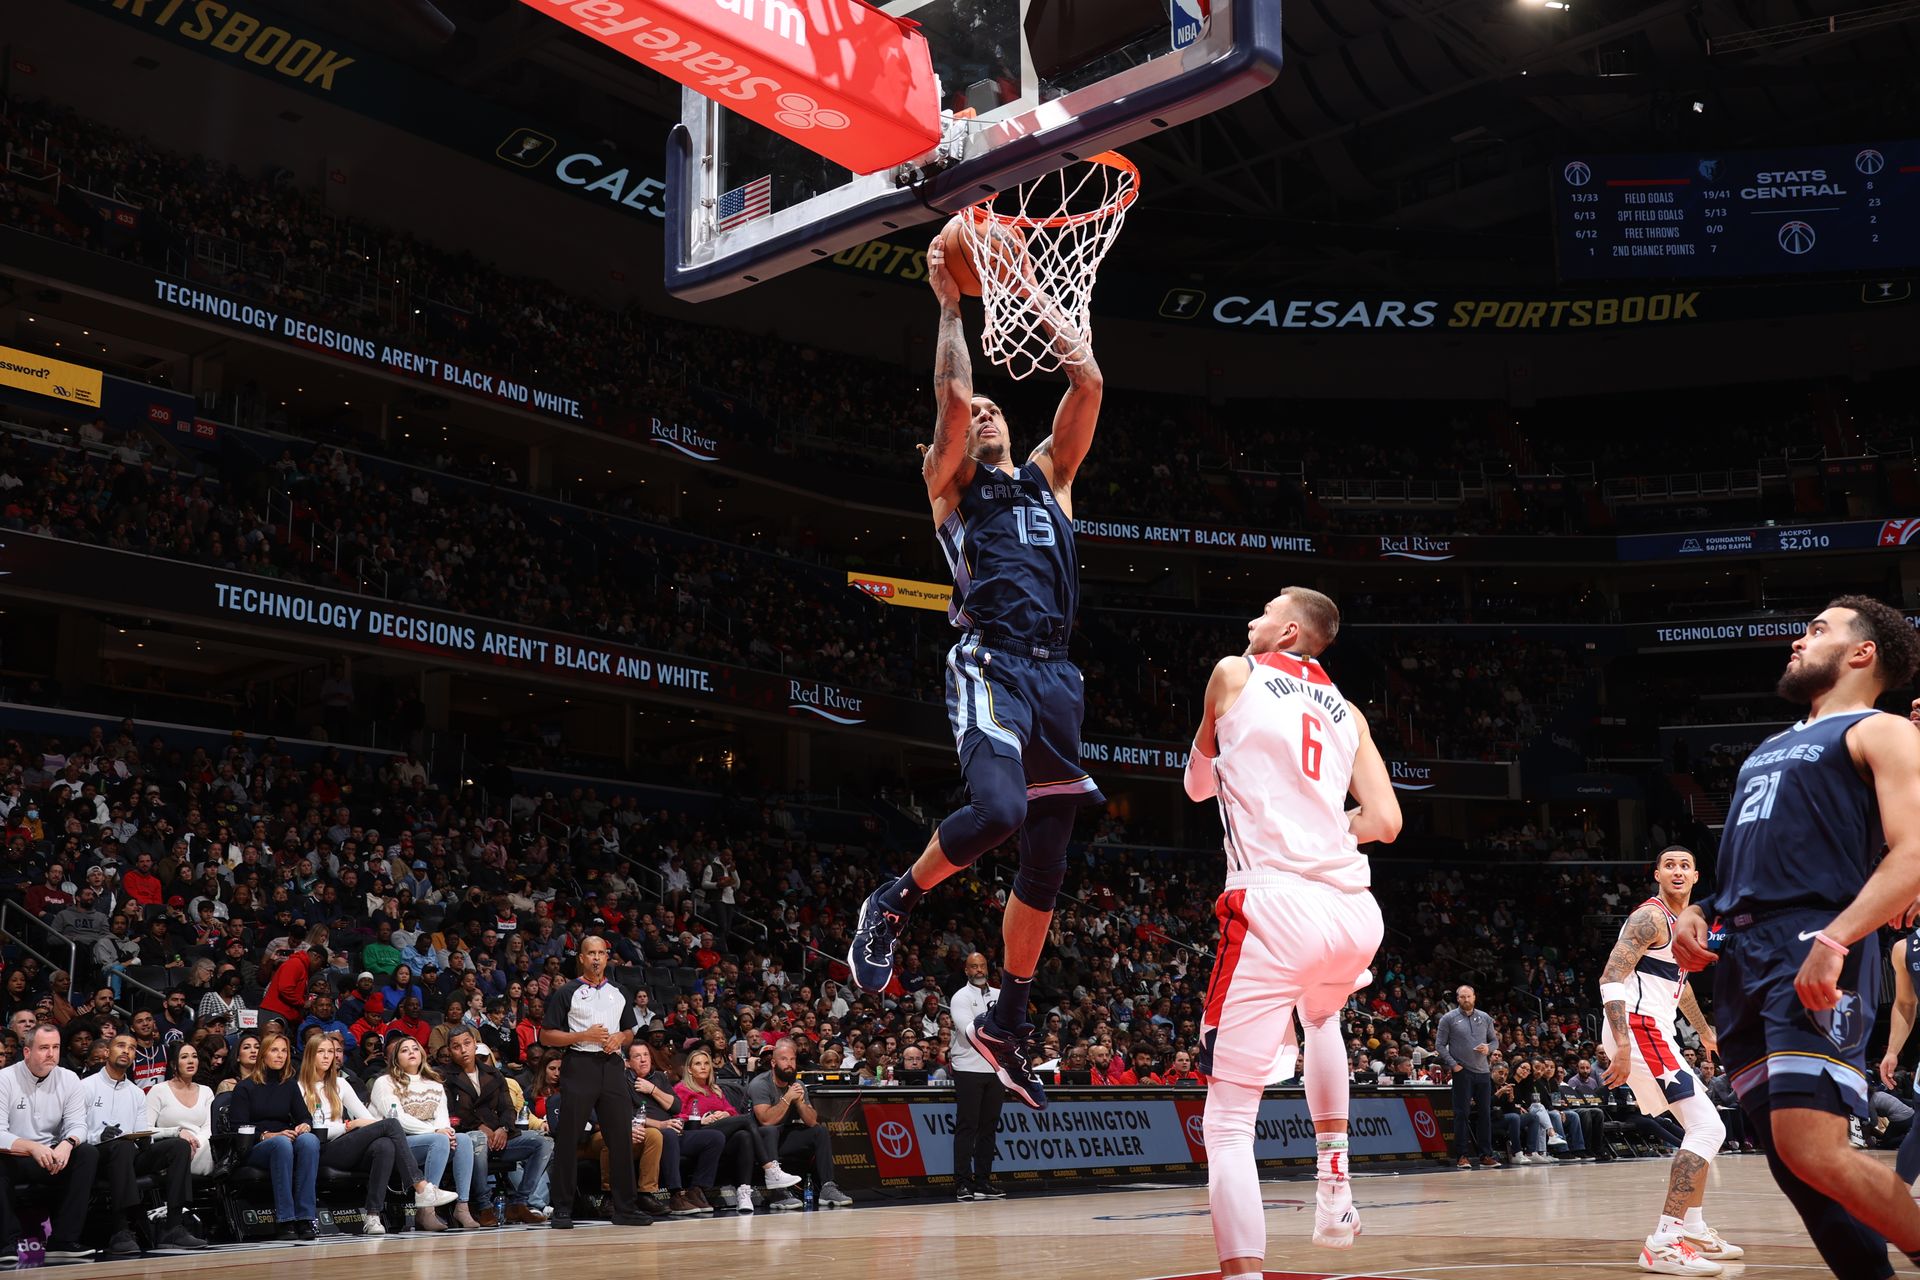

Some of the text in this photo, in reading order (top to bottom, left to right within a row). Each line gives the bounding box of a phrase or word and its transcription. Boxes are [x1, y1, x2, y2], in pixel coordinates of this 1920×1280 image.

[1177, 22, 1197, 45] NBA
[1756, 169, 1828, 185] STATS
[1740, 183, 1847, 200] CENTRAL
[1866, 181, 1874, 190] 8
[1571, 193, 1599, 202] 13/33
[1624, 192, 1674, 204] FIELD GOALS
[1703, 190, 1731, 199] 19/41
[1867, 197, 1881, 207] 23
[1573, 211, 1596, 220] 6/13
[1617, 209, 1684, 222] 3PT FIELD GOALS
[1704, 208, 1727, 217] 5/13
[1869, 215, 1877, 224] 2
[1575, 230, 1598, 239] 6/12
[1624, 227, 1680, 239] FREE THROWS
[1706, 224, 1724, 234] 0/0
[1872, 233, 1880, 243] 2
[1612, 243, 1696, 257] 2ND CHANCE POINTS
[1710, 245, 1718, 254] 7
[1212, 290, 1701, 328] CAESARS SPORTSBOOK
[154, 279, 584, 420] TECHNOLOGY DECISIONS AREN'T BLACK AND WHITE.
[151, 408, 169, 420] 200
[196, 423, 214, 436] 229
[651, 417, 718, 451] Red River
[1012, 505, 1056, 547] 15
[1779, 529, 1812, 537] JACKPOT
[1073, 518, 1316, 552] DECISIONS AREN'T BLACK AND WHITE.
[1706, 536, 1751, 544] FOUNDATION
[1380, 536, 1451, 552] Red River
[1780, 535, 1830, 550] $2,010
[898, 587, 922, 598] What's
[924, 592, 938, 601] your
[214, 583, 714, 693] TECHNOLOGY DECISIONS AREN'T BLACK AND WHITE.
[1657, 625, 1743, 642] TECHNOLOGY
[790, 680, 862, 712] Red River
[1302, 713, 1323, 781] 6
[1113, 746, 1161, 766] AREN'T
[1391, 761, 1432, 779] River
[1737, 771, 1781, 825] 21
[75, 918, 95, 929] CAT
[1032, 1110, 1150, 1132] WASHINGTON
[1005, 1137, 1077, 1160] TOYOTA
[1082, 1136, 1145, 1158] DEALER
